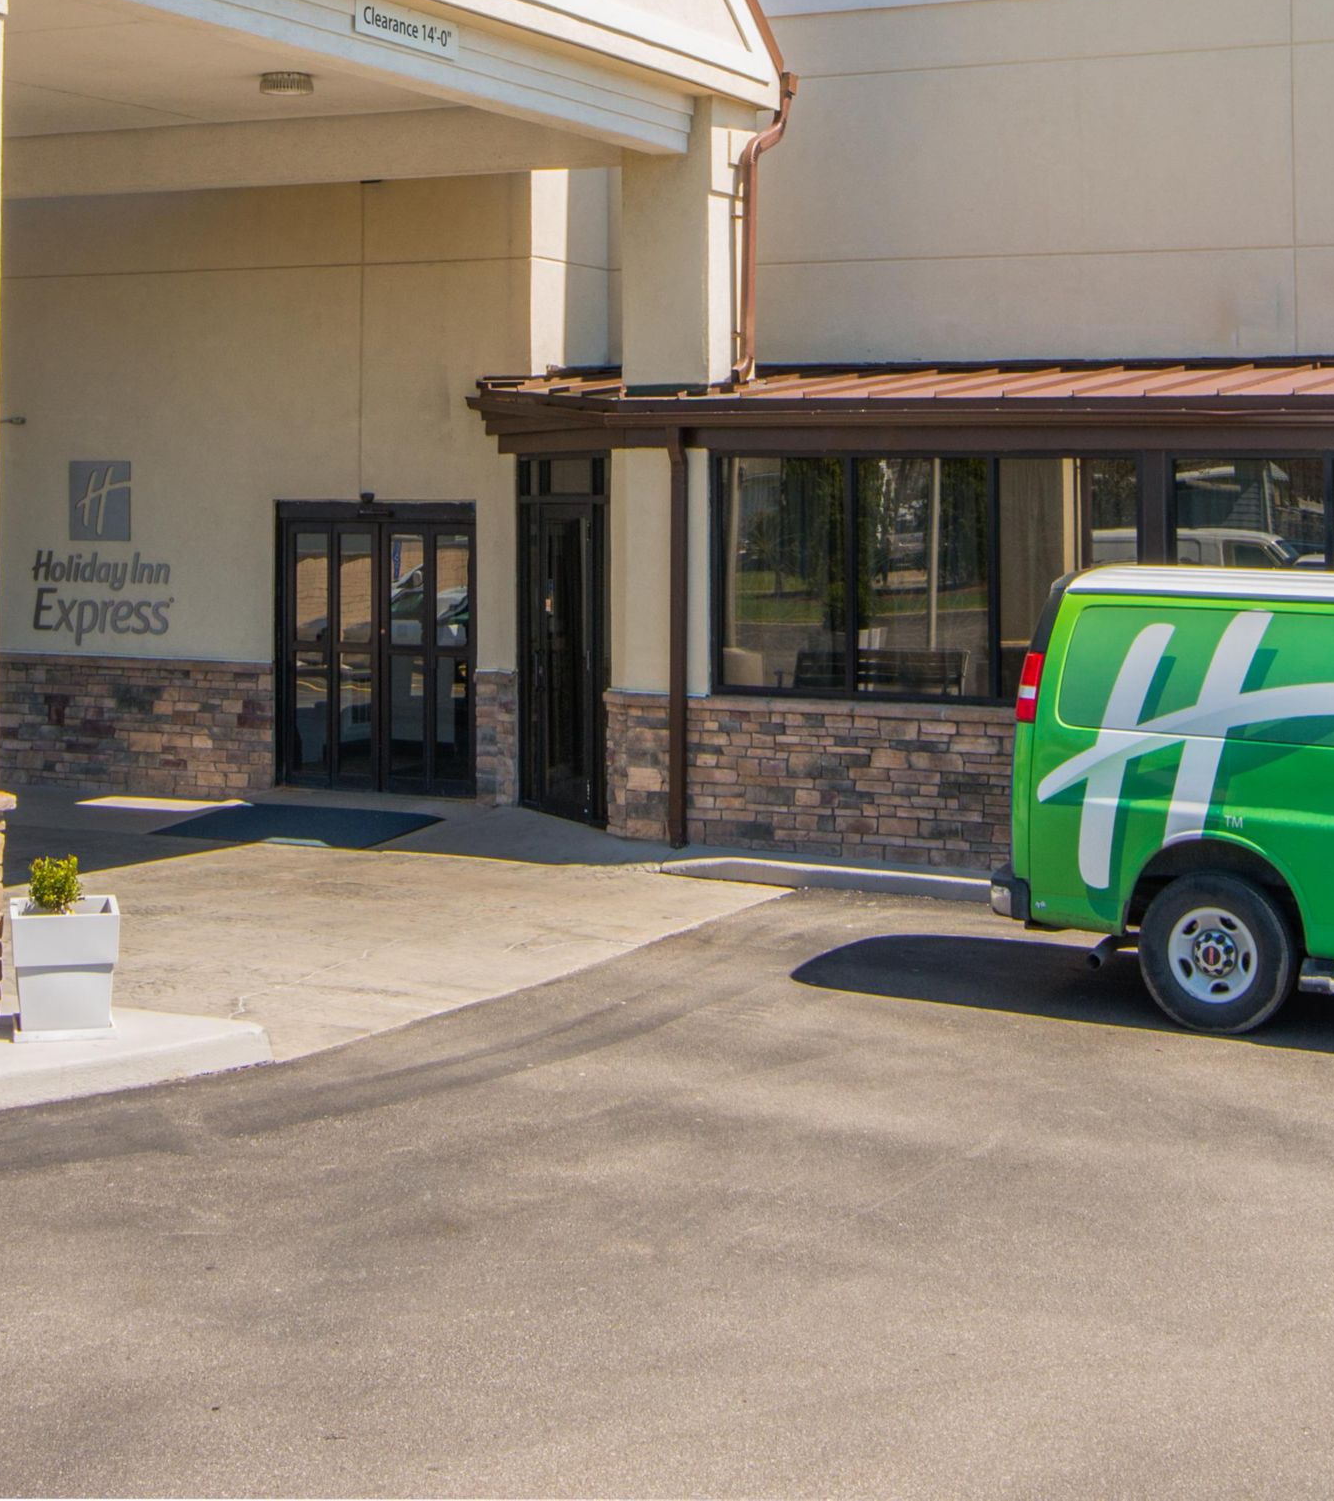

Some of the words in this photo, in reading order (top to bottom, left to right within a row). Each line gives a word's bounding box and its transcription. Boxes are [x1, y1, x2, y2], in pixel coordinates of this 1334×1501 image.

[363, 6, 419, 39] Clearance
[422, 24, 451, 47] 14'-0"
[32, 550, 128, 591] Holiday
[130, 552, 171, 585] Inn
[33, 587, 171, 646] Express
